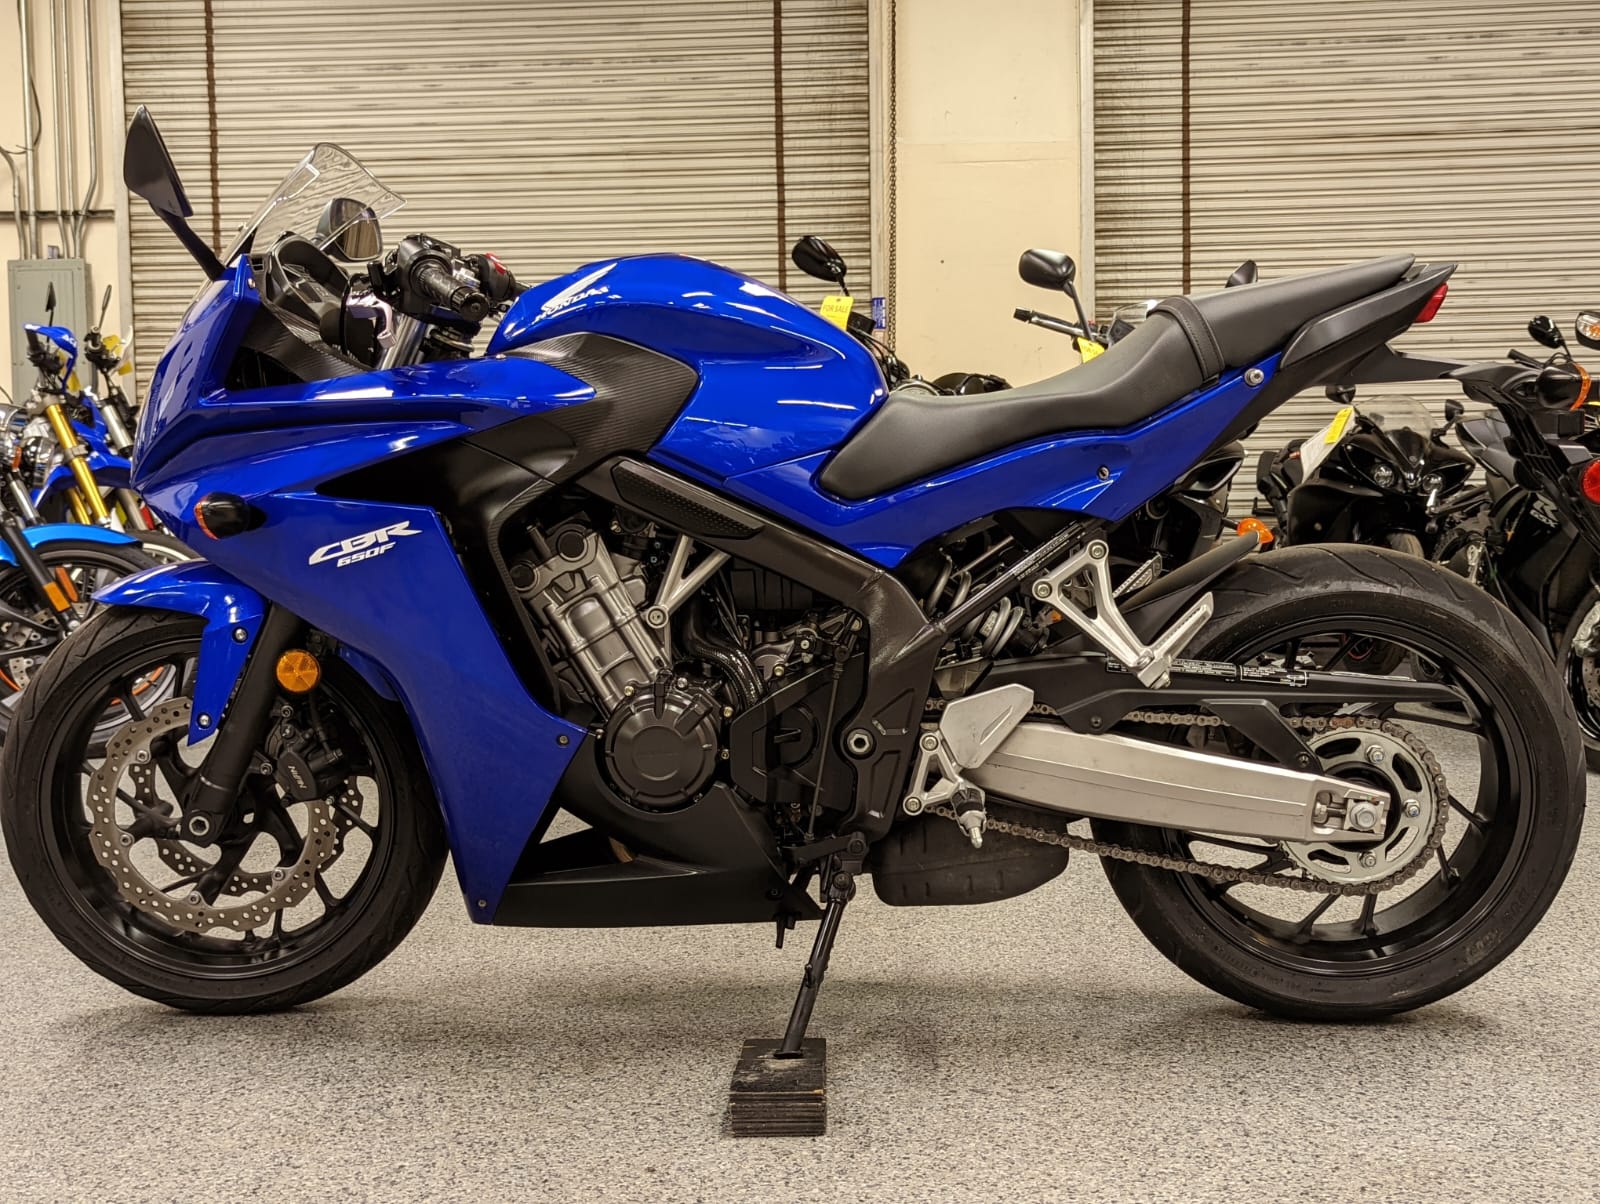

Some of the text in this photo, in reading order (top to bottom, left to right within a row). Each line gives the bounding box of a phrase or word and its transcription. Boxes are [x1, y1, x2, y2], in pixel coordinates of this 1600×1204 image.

[530, 286, 609, 326] HONDA
[822, 304, 849, 313] FOR SALE
[309, 520, 423, 565] CBR
[337, 541, 396, 568] 650F
